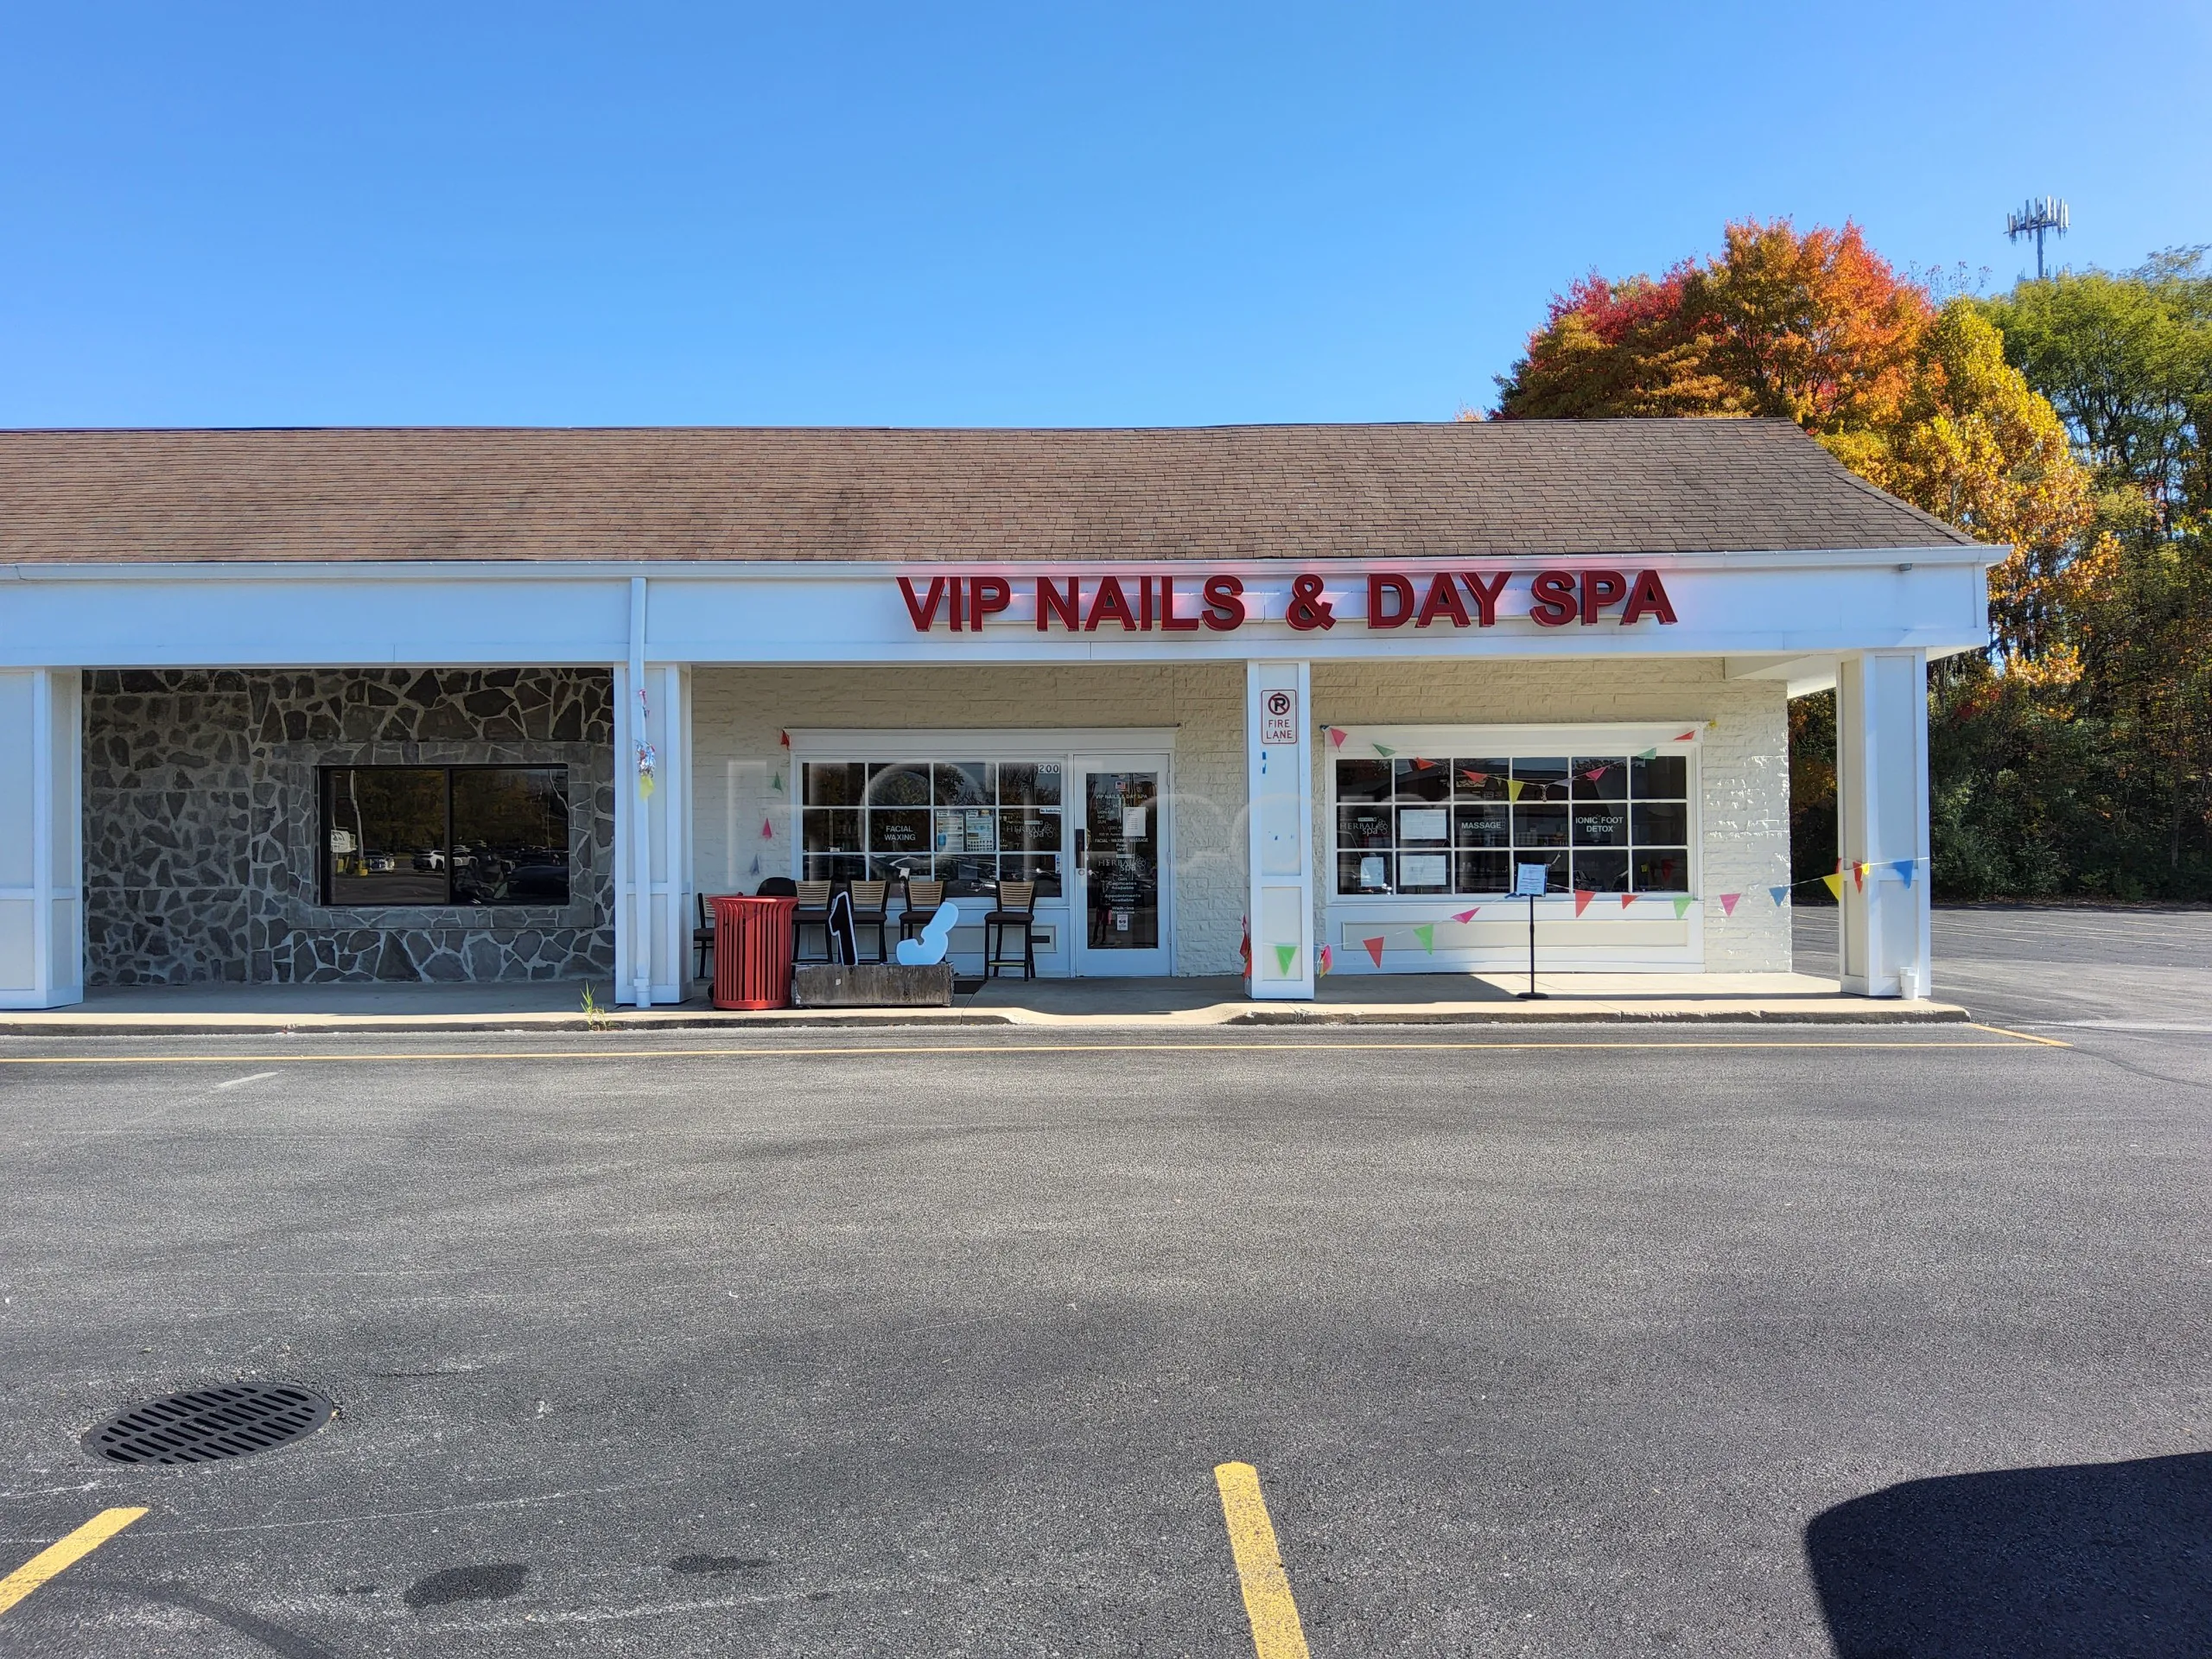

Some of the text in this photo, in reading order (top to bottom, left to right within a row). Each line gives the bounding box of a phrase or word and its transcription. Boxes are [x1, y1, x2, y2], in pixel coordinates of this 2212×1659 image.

[896, 569, 1678, 632] VIP NAILS & DAY SPA
[1268, 719, 1291, 728] FIRE
[1266, 730, 1293, 740] LANE
[1039, 764, 1060, 773] 200
[1028, 830, 1045, 839] spa
[1362, 827, 1378, 836] spa
[1120, 864, 1136, 874] spa
